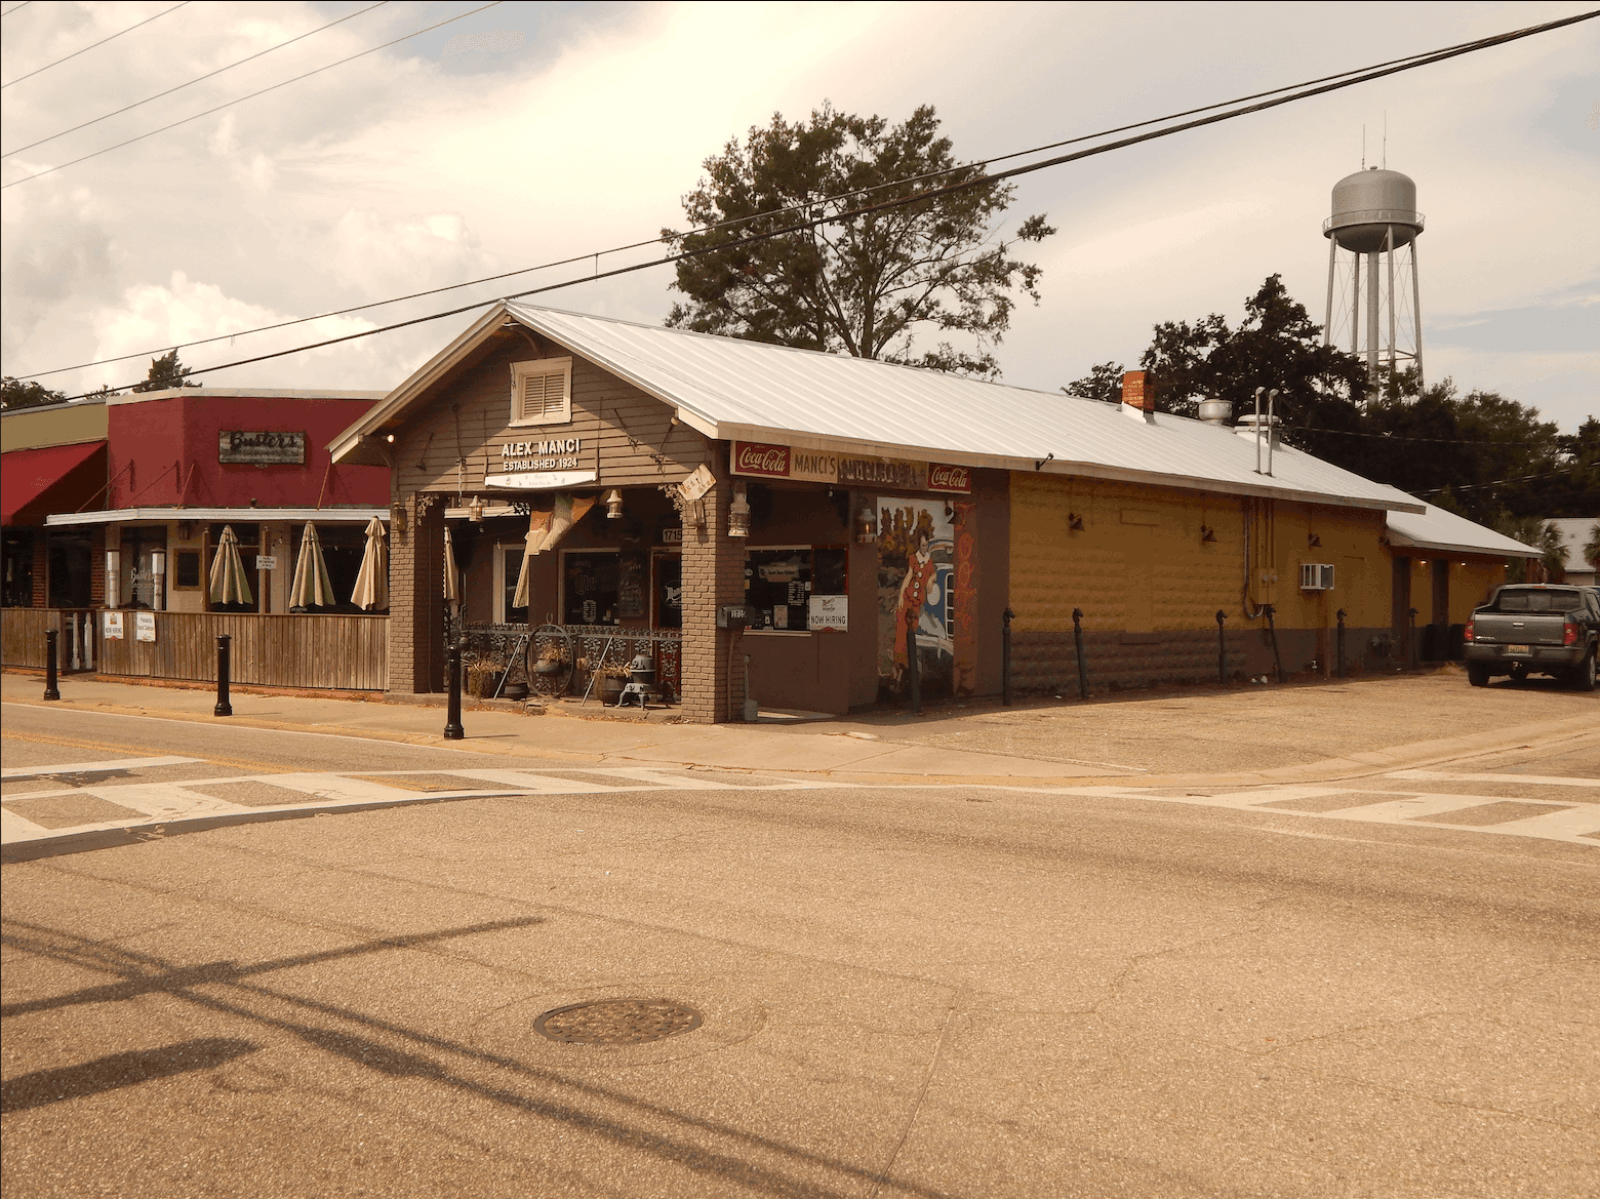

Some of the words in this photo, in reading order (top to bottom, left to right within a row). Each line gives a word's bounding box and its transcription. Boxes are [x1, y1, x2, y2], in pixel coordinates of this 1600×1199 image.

[501, 441, 533, 457] ALEX
[539, 438, 580, 455] MANCI
[503, 460, 556, 471] ESTABLISHED
[558, 457, 577, 469] 1924
[794, 454, 836, 476] MANCI'S
[810, 615, 825, 625] NOW
[825, 615, 846, 625] HIRING
